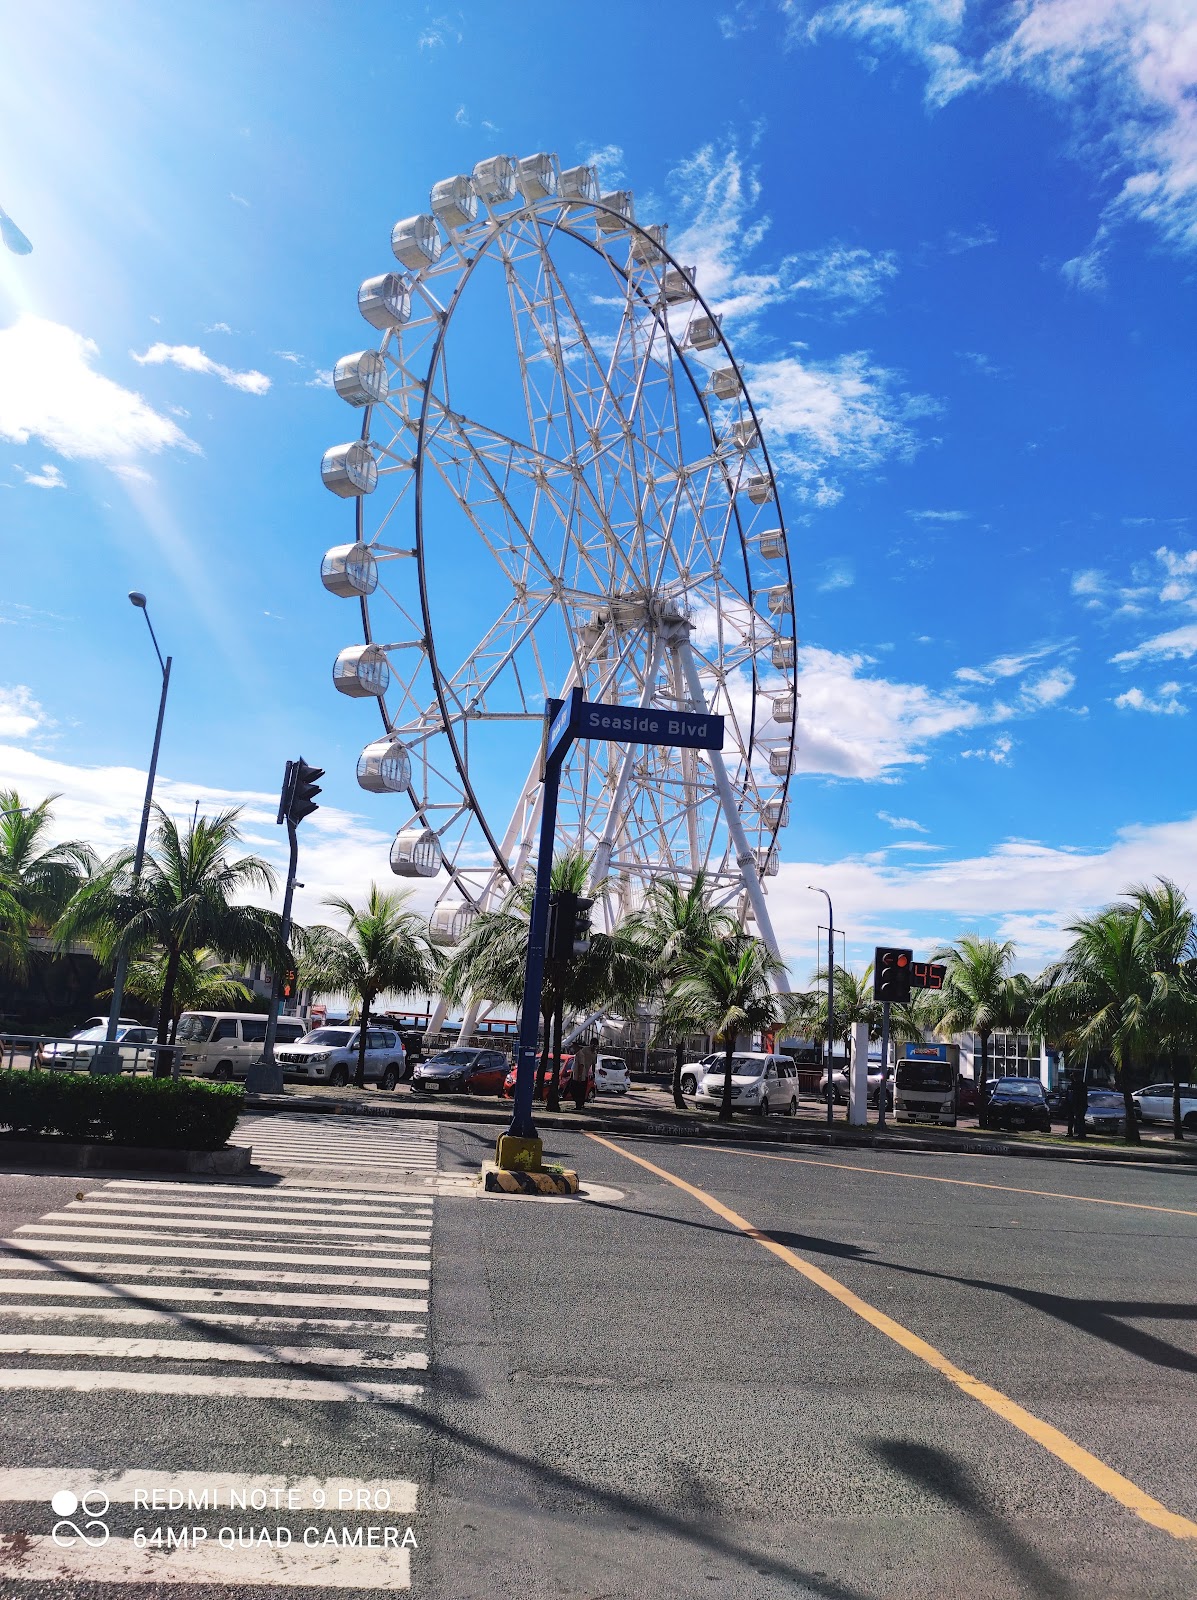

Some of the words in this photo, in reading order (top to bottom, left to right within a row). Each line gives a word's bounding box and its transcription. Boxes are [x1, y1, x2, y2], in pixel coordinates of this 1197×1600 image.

[589, 712, 659, 733] Seaside
[668, 720, 708, 738] Blvd
[914, 964, 942, 989] 45
